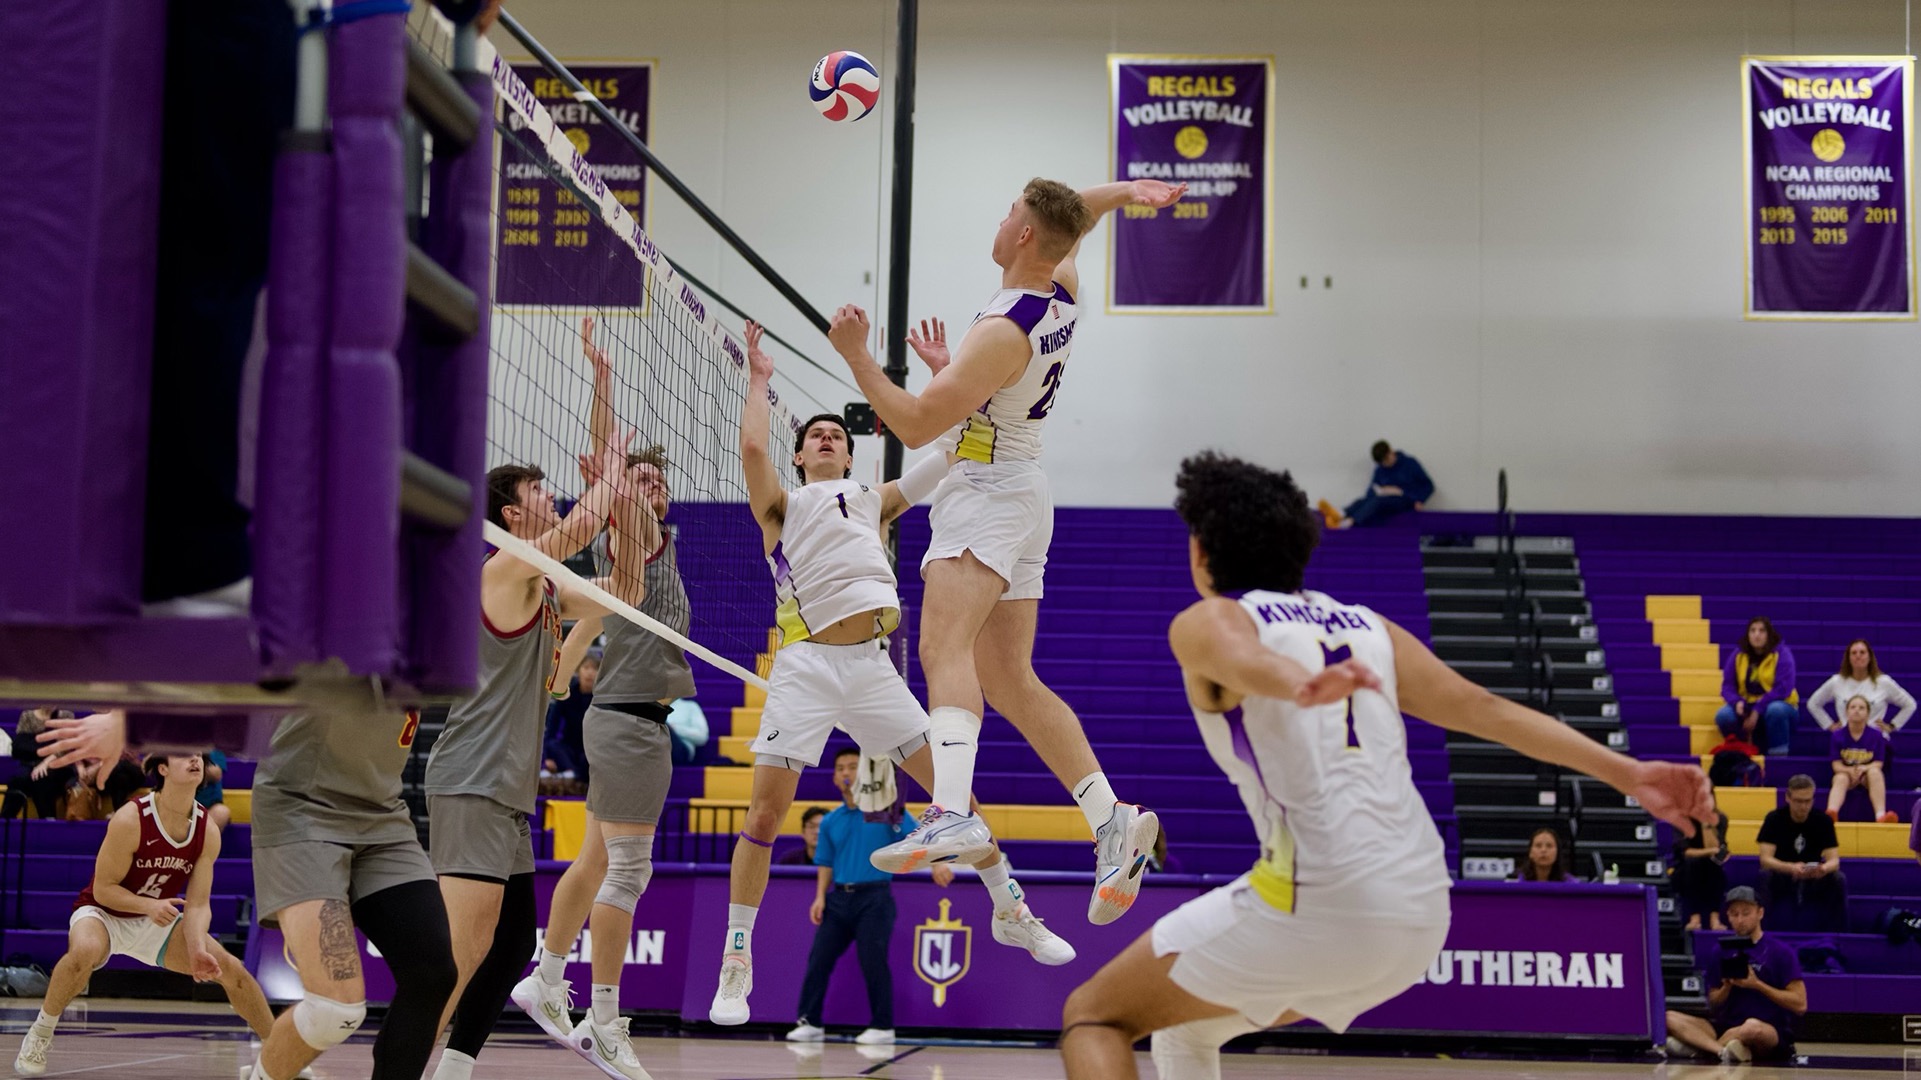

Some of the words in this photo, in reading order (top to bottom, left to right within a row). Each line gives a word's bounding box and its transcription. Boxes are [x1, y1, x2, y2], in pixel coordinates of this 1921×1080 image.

[1148, 76, 1236, 97] REGALS
[1782, 78, 1873, 100] REGALS
[1123, 101, 1254, 128] VOLLEYBALL
[1759, 103, 1893, 131] VOLLEYBALL
[1128, 162, 1174, 178] NCAA
[1175, 163, 1252, 178] NATIONAL
[1766, 166, 1810, 182] NCAA
[1814, 167, 1893, 182] REGIONAL
[1785, 185, 1880, 201] CHAMPIONS
[1759, 207, 1795, 223] 1995
[1811, 207, 1848, 223] 2006
[1864, 207, 1897, 224] 2011
[1759, 228, 1795, 244] 2013
[1812, 228, 1848, 244] 2015
[1027, 361, 1066, 420] 2
[836, 492, 849, 519] 1
[1466, 860, 1511, 873] EAST
[1418, 950, 1624, 988] UTHERAN
